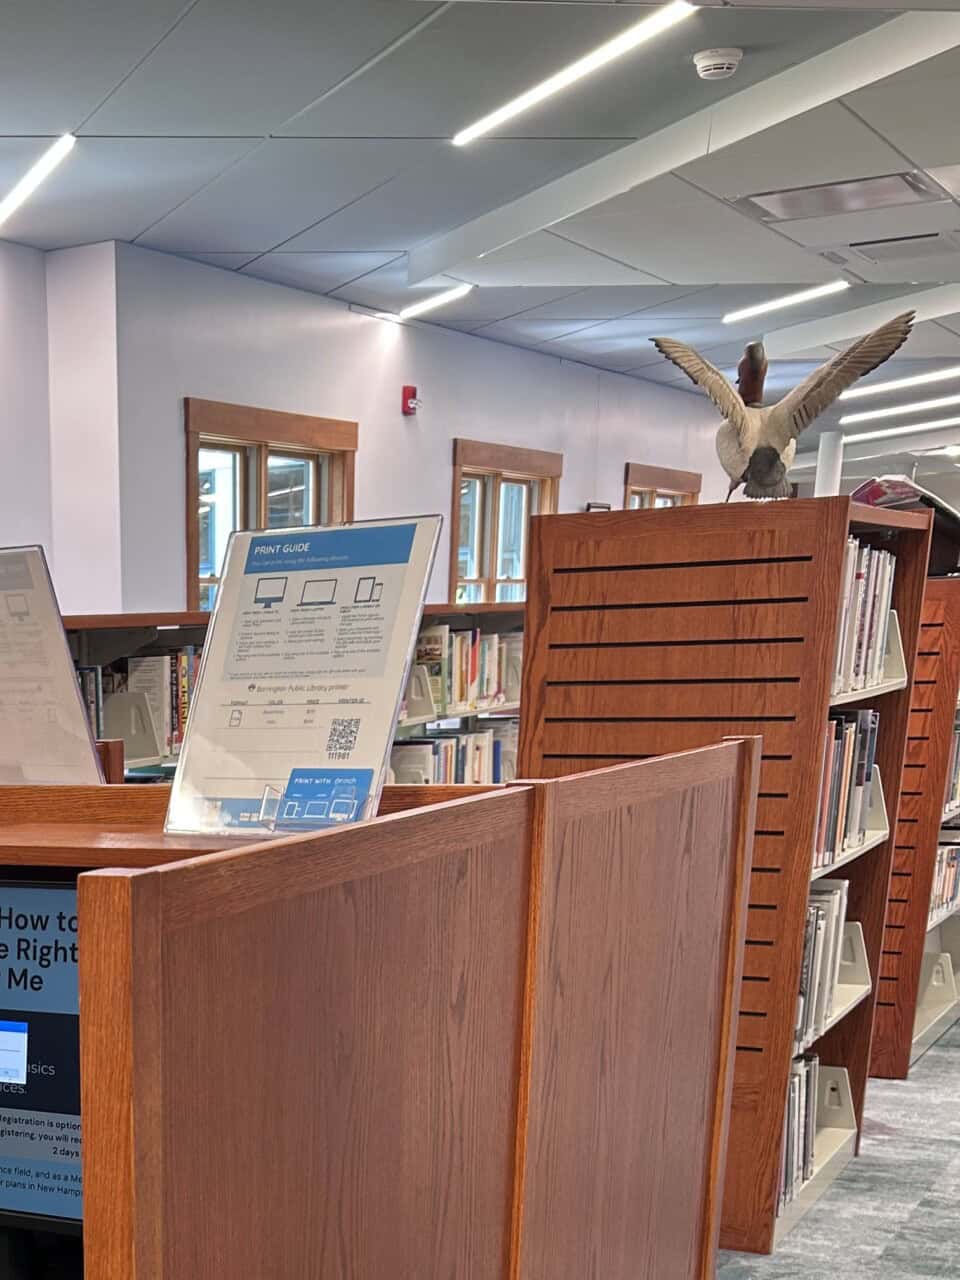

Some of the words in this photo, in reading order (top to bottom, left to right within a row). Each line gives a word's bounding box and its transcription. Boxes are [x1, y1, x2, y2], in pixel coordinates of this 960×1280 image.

[254, 544, 280, 555] PRINT
[282, 543, 311, 552] GUIDE
[57, 912, 78, 932] to
[17, 938, 79, 968] Right
[8, 968, 43, 991] Me
[56, 1122, 82, 1130] option
[38, 1134, 54, 1142] you
[59, 1148, 80, 1159] days
[35, 1170, 50, 1179] and
[5, 1180, 26, 1189] plans
[37, 1184, 55, 1193] New
